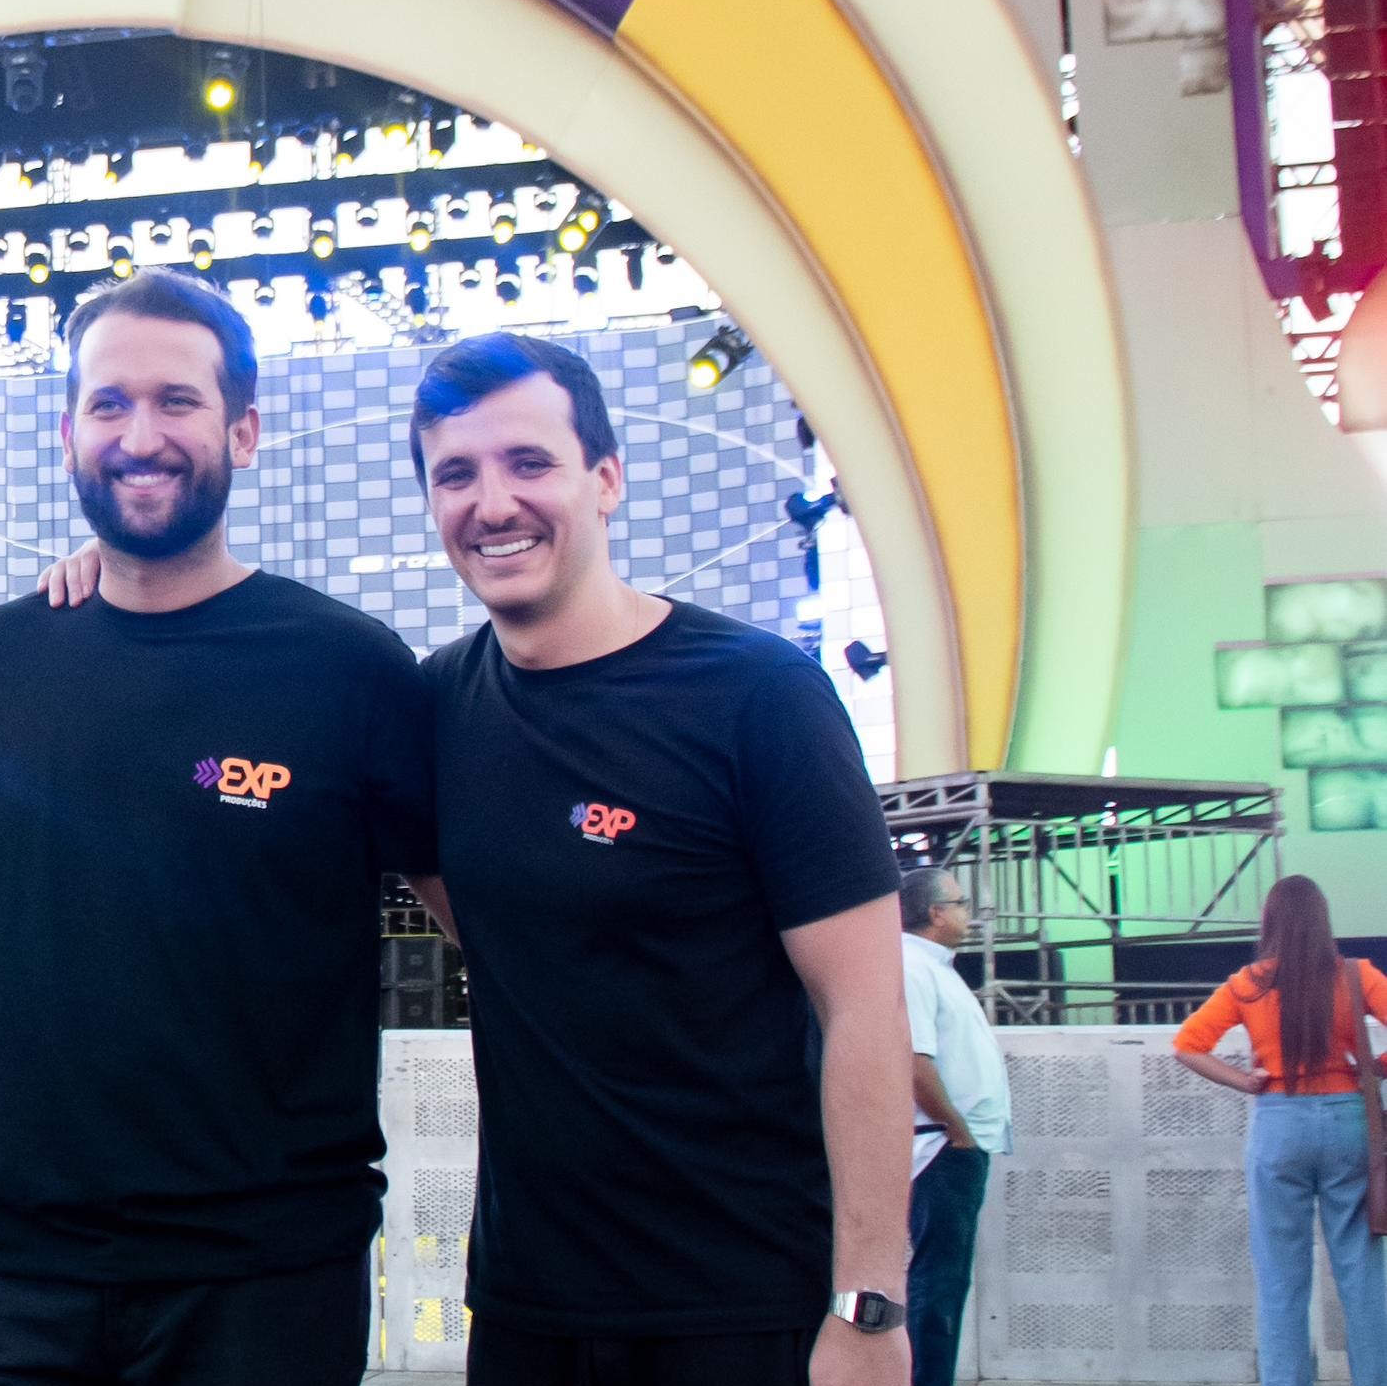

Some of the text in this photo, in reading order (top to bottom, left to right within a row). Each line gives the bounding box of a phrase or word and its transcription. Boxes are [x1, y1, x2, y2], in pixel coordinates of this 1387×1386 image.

[217, 757, 292, 800] EXP
[219, 794, 268, 809] PRODUÇÕES
[581, 803, 637, 839] EXP
